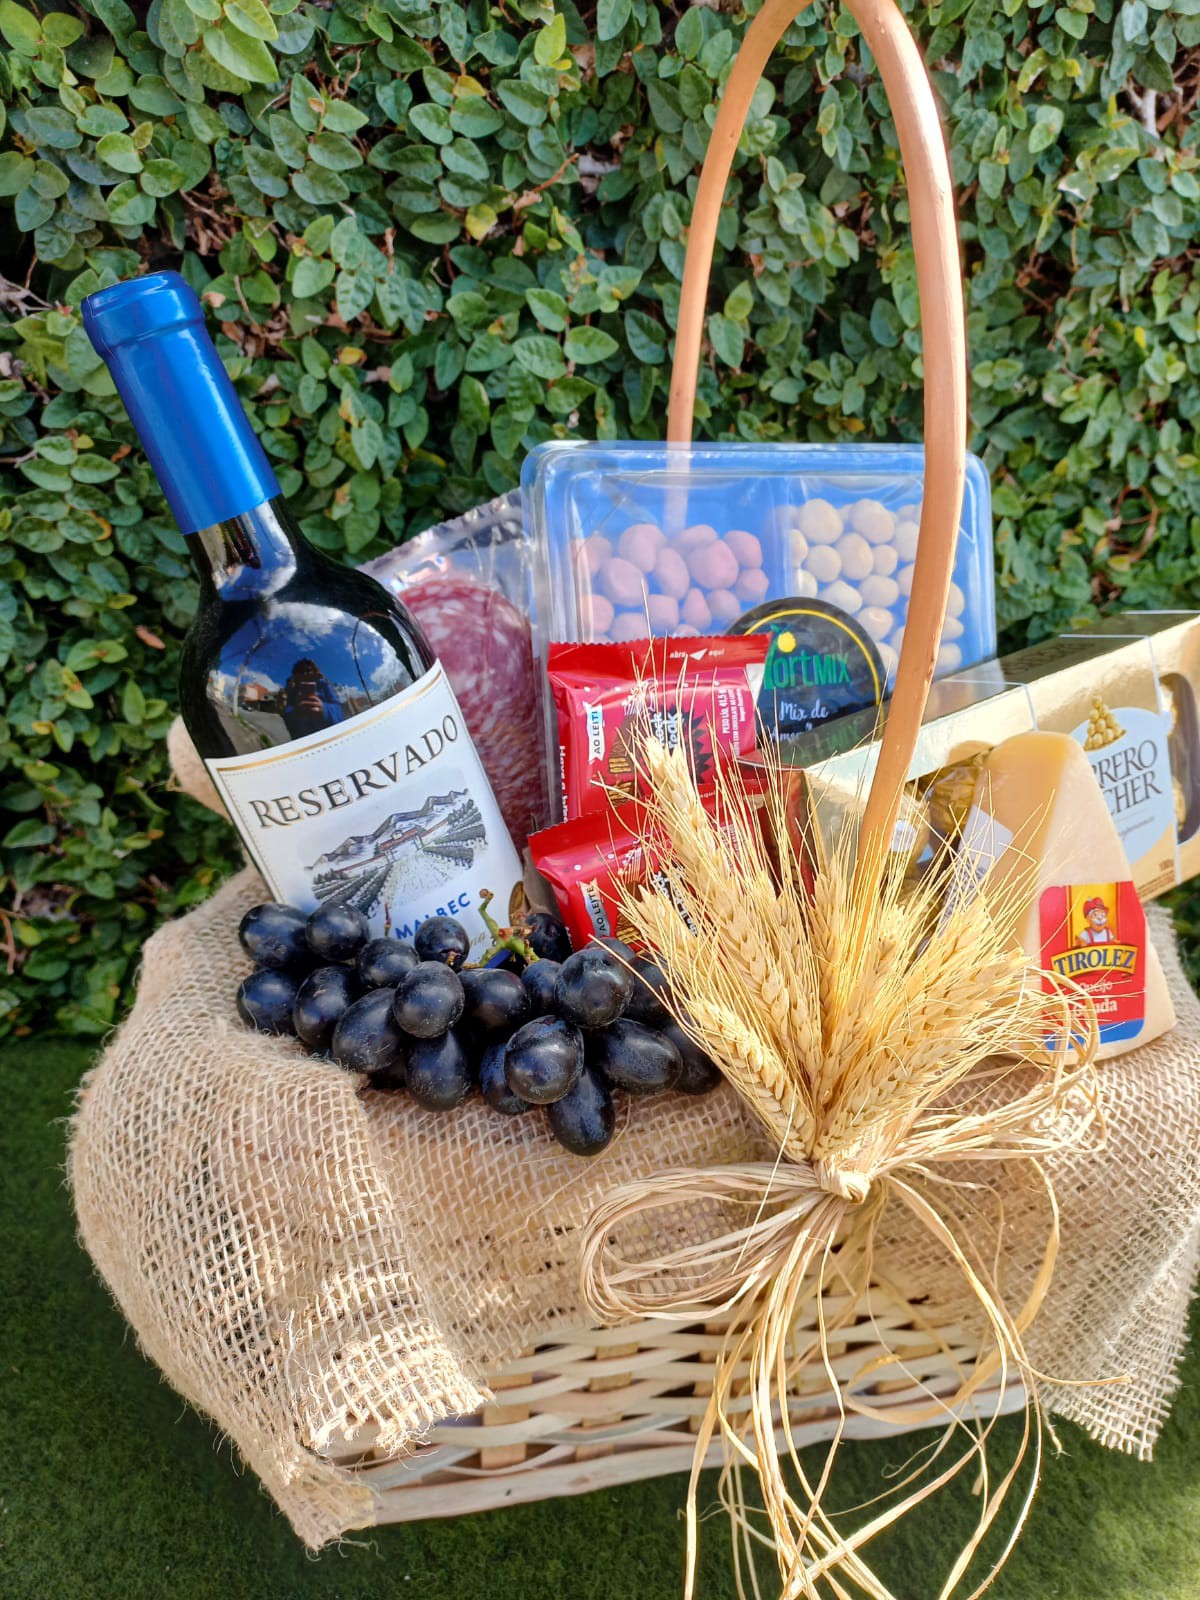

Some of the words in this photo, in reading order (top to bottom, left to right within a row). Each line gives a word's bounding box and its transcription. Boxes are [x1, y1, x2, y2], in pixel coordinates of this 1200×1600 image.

[779, 700, 808, 721] Mix
[811, 698, 829, 719] de
[593, 739, 602, 754] AO
[248, 713, 459, 830] RESERVADO
[1092, 739, 1158, 790] RERO
[586, 884, 602, 915] LEITE
[394, 892, 471, 940] MABEC
[595, 916, 608, 932] AO
[1053, 948, 1138, 978] TIROLEZ
